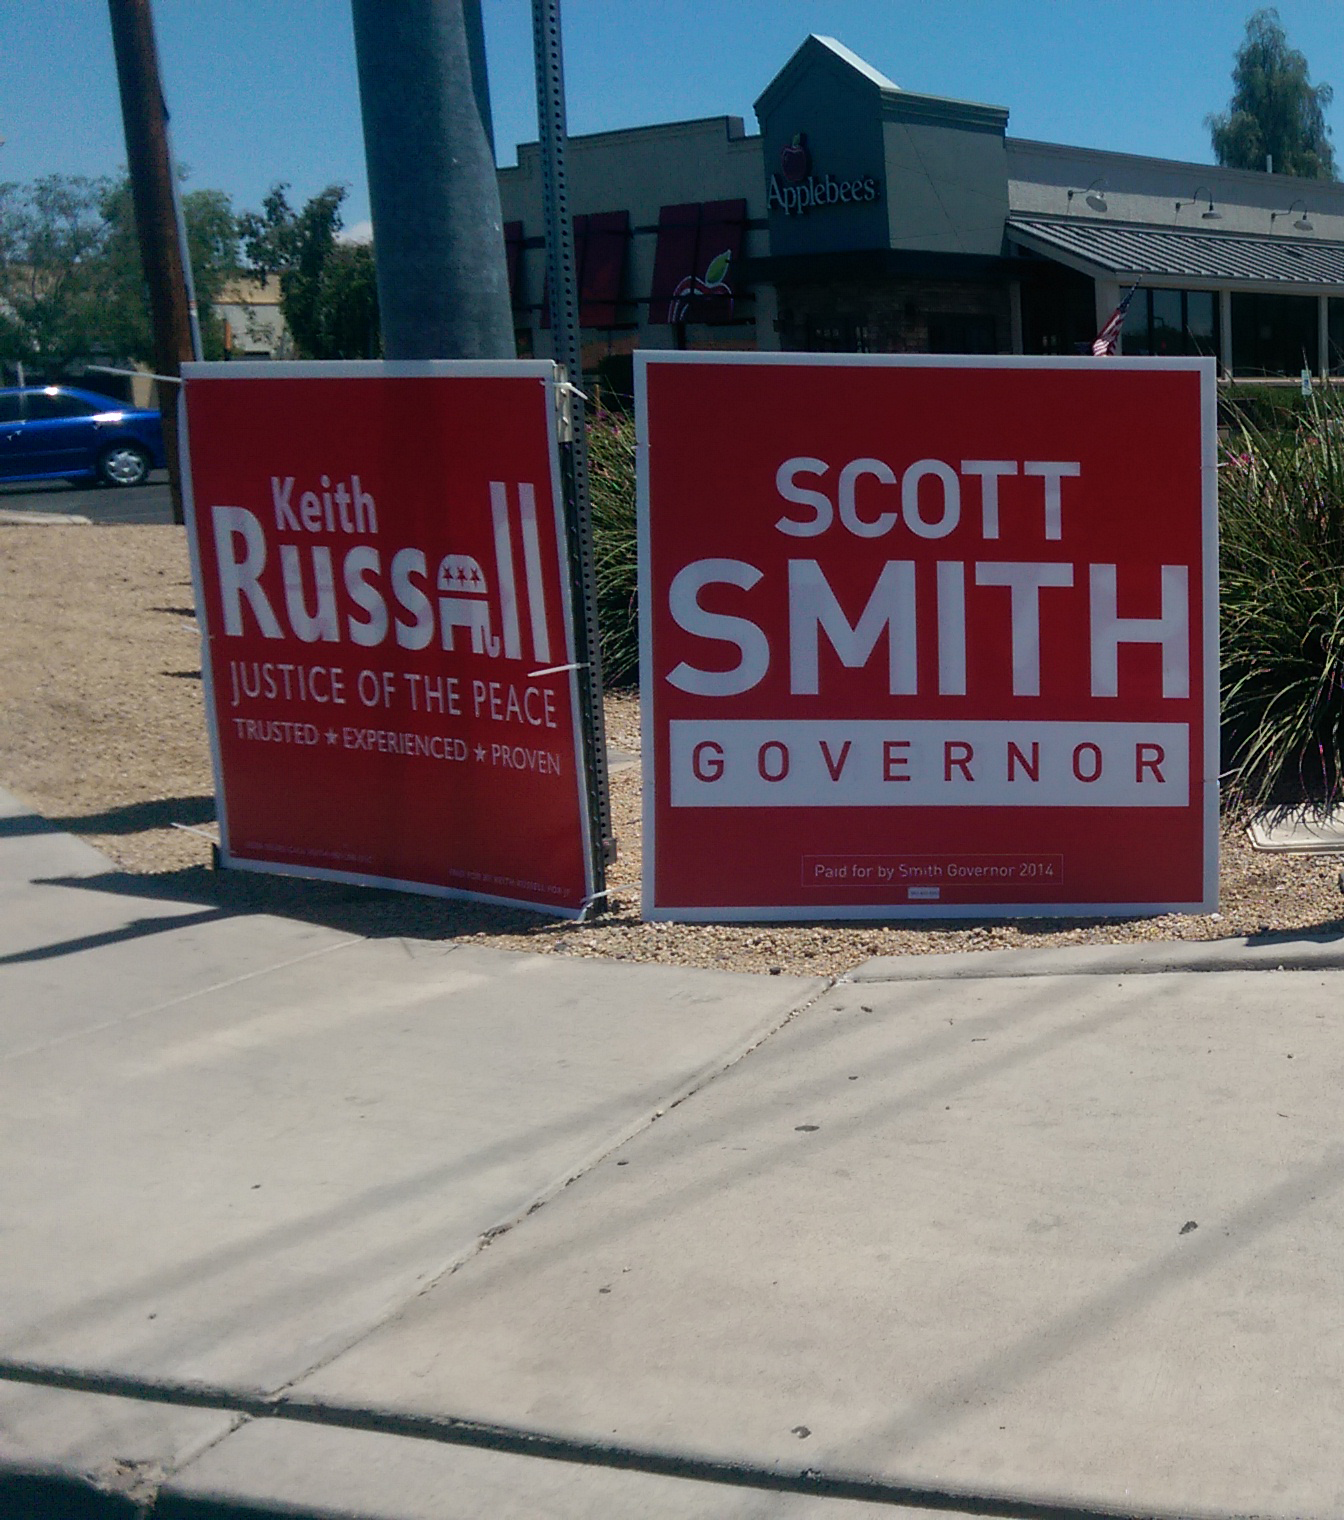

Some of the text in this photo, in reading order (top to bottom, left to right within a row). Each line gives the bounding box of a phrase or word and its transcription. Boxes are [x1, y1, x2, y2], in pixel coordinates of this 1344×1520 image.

[272, 475, 378, 534] Keith
[774, 456, 1080, 540] SCOTT
[664, 558, 1190, 699] SMITH
[230, 661, 557, 728] JUSTICE OF THE PEACE
[233, 719, 561, 775] TRUSTED EXPERIENCED PROVEN
[691, 740, 1166, 783] GOVERNOR
[814, 863, 1054, 880] Paid for by Smith Governor 2014
